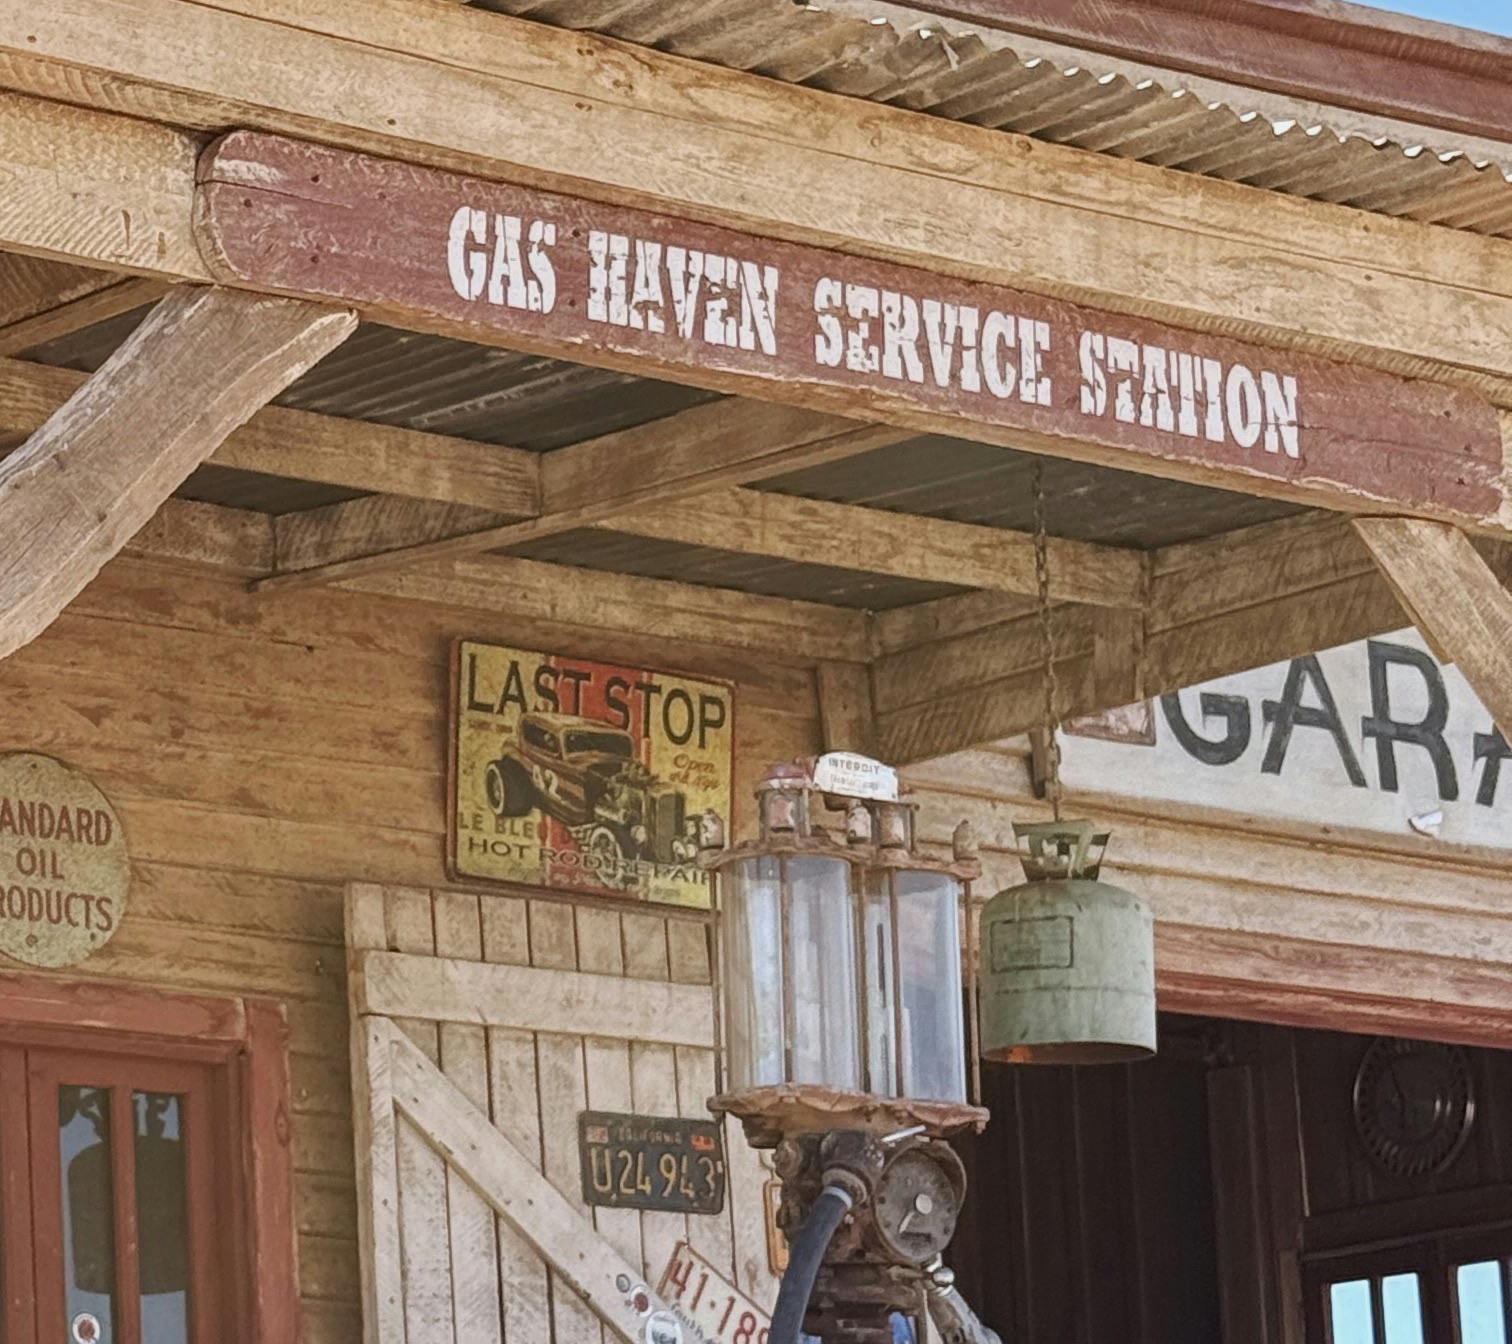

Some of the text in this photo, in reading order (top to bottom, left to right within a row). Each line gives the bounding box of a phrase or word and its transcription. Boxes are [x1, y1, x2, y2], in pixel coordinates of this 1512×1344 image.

[447, 206, 1300, 459] GAS HAVEN SERVICE STATION
[467, 653, 726, 750] LAST STOP
[16, 847, 66, 881] OIL
[467, 837, 532, 859] HOT
[539, 847, 603, 870] ROD
